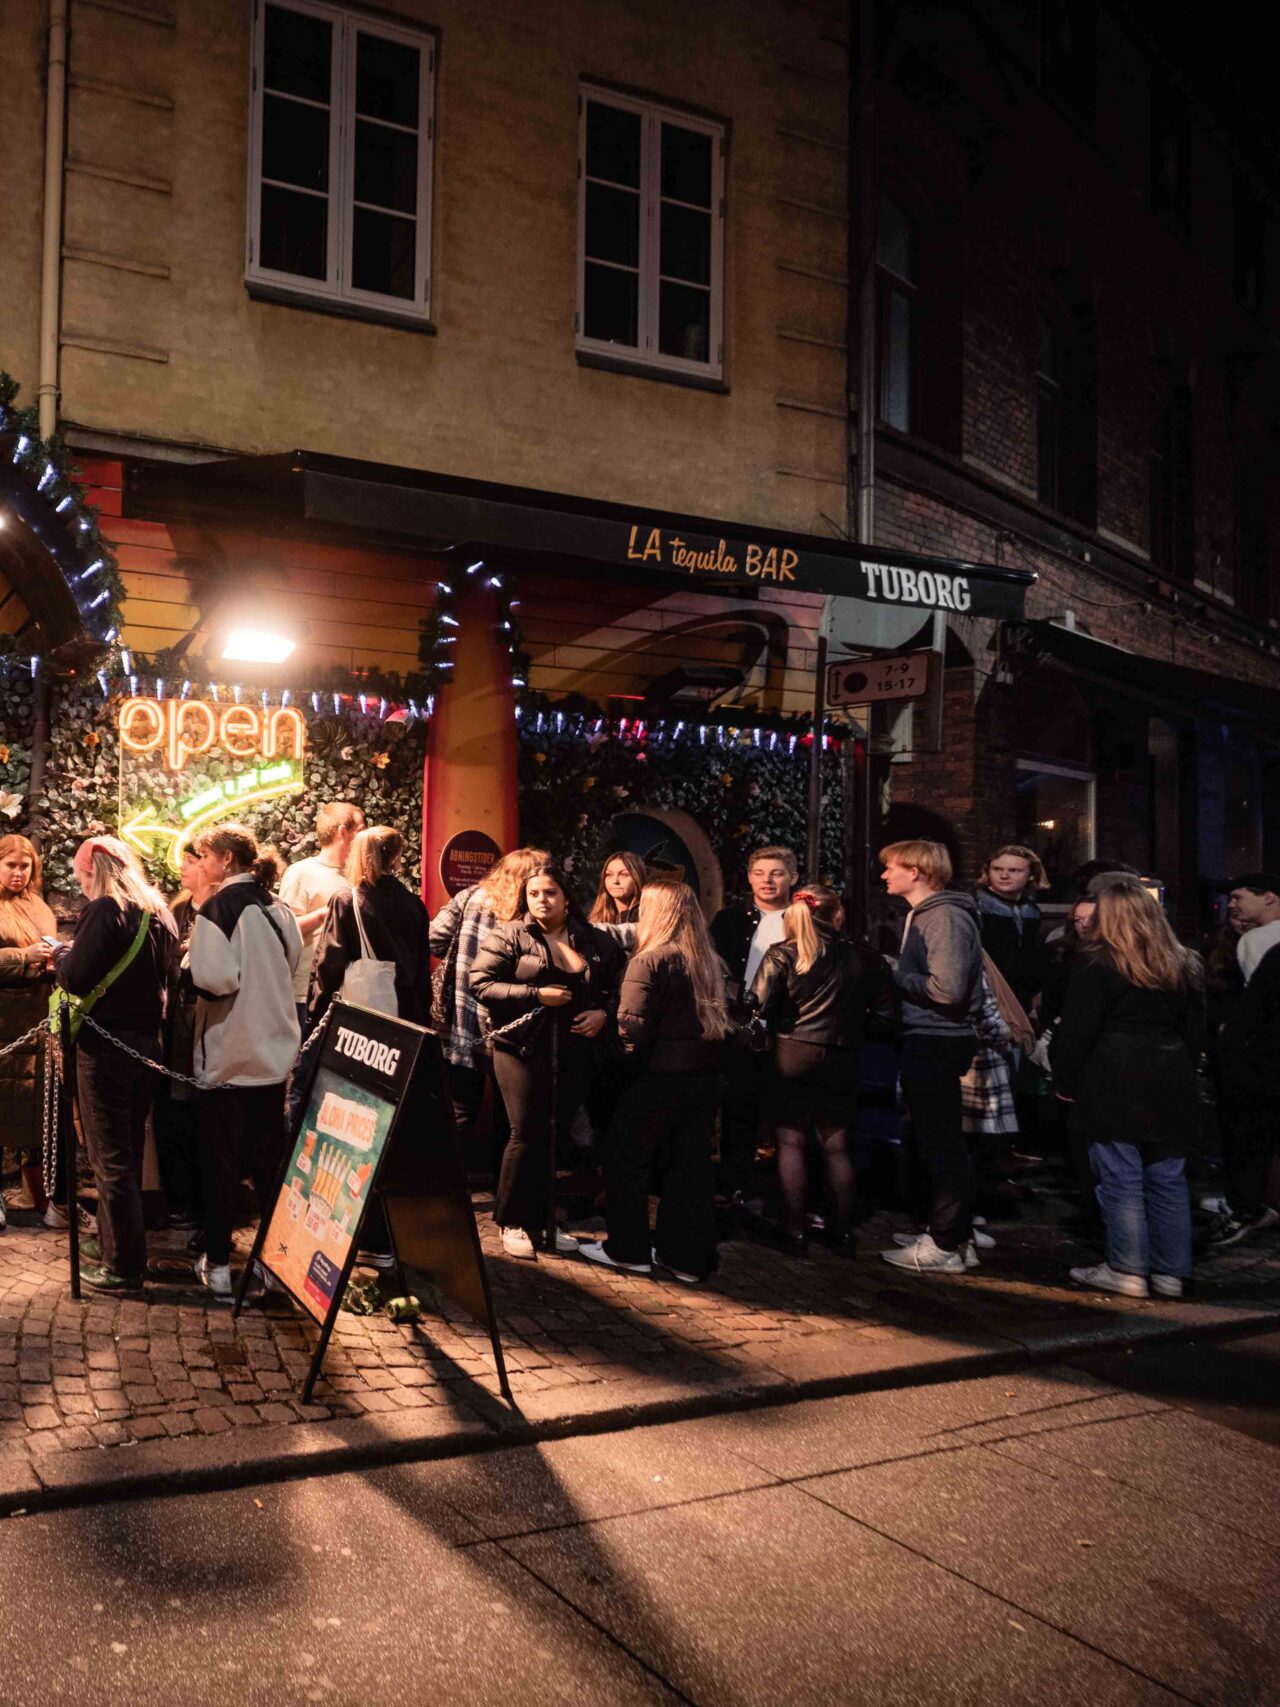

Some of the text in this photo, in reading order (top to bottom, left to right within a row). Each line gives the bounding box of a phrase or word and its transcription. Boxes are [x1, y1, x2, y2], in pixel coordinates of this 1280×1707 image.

[628, 524, 800, 582] LA tequila BAR
[860, 560, 972, 611] TUBORG
[877, 677, 916, 692] 15-17
[886, 663, 910, 675] 7-9
[118, 698, 306, 770] open
[334, 1026, 401, 1076] TUBORG
